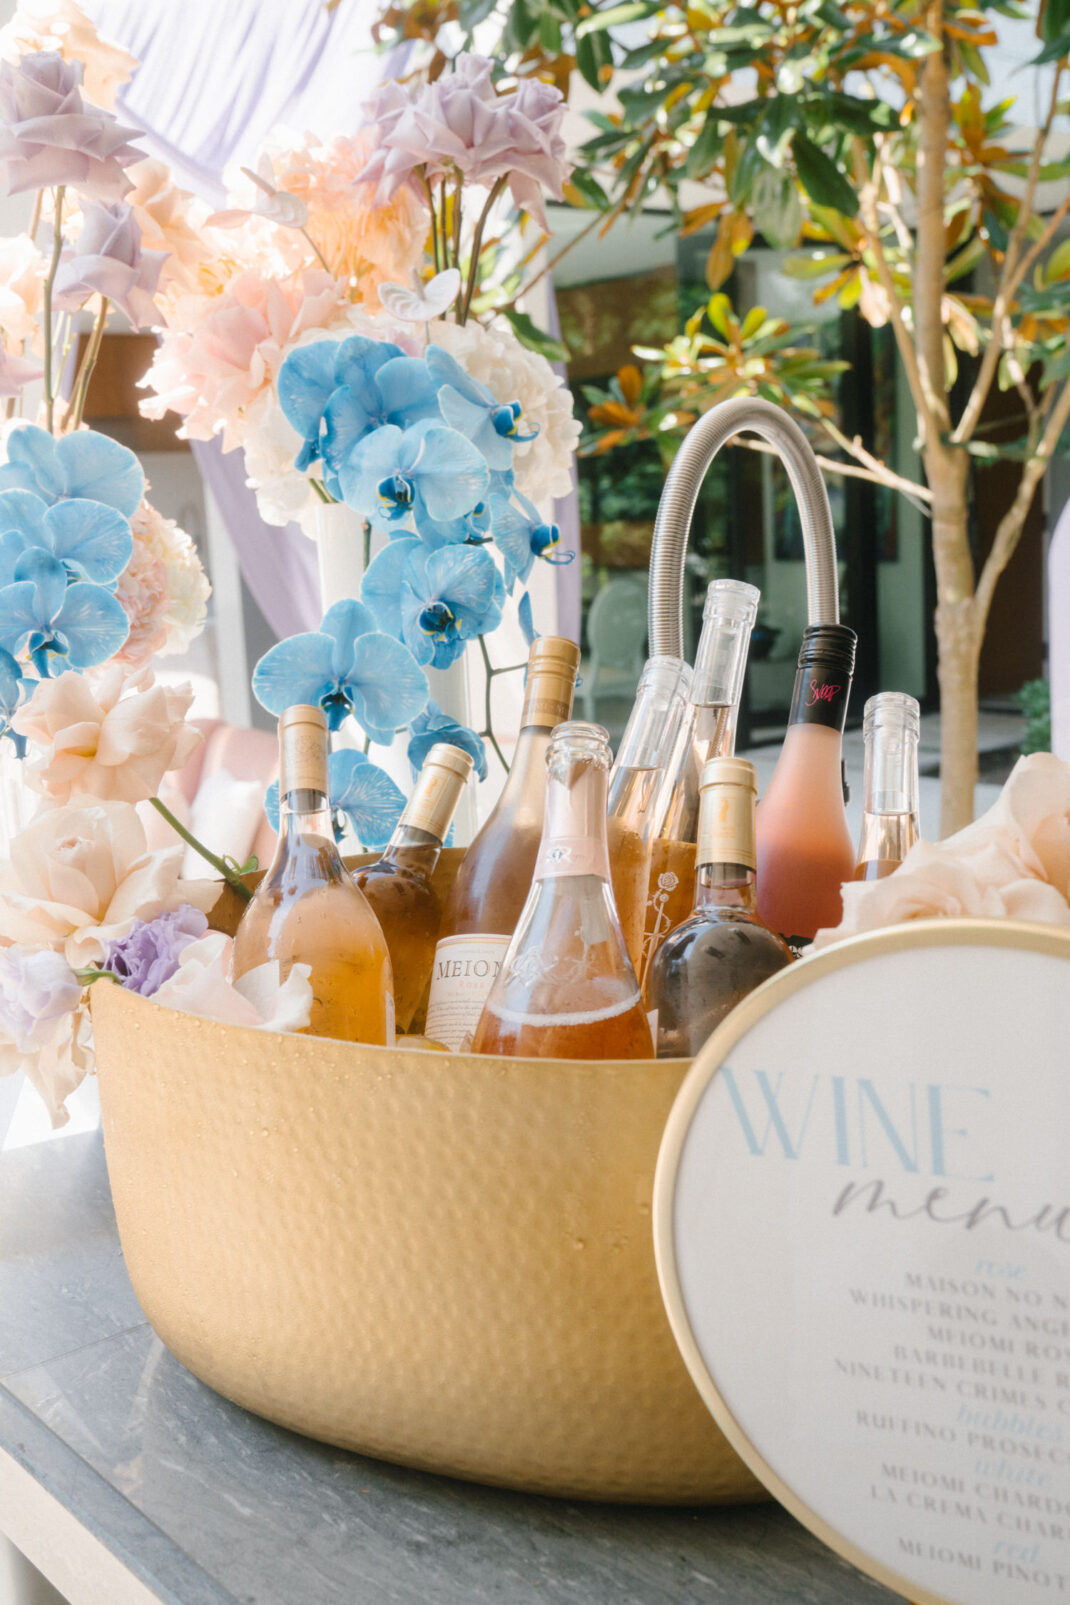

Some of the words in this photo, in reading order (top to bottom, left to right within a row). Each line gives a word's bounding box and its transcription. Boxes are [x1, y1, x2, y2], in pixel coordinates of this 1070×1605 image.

[720, 1066, 995, 1182] WINE
[832, 1179, 1070, 1242] menu
[849, 1287, 997, 1326] WHISPERING
[906, 1272, 995, 1299] MAISON
[1006, 1286, 1042, 1306] NO
[928, 1325, 1014, 1354] MEIOMI
[834, 1358, 945, 1391] NINETEEN
[956, 1379, 1046, 1411] CRIMES
[856, 1410, 957, 1442] RUFFINO
[967, 1431, 1070, 1464] PROSEC
[882, 1462, 966, 1494] MEIOMI
[870, 1484, 898, 1504] LA
[906, 1492, 988, 1524] CREMA
[996, 1511, 1070, 1542] CHAR
[899, 1536, 982, 1572] MEIOMI
[992, 1559, 1067, 1591] PINOT
